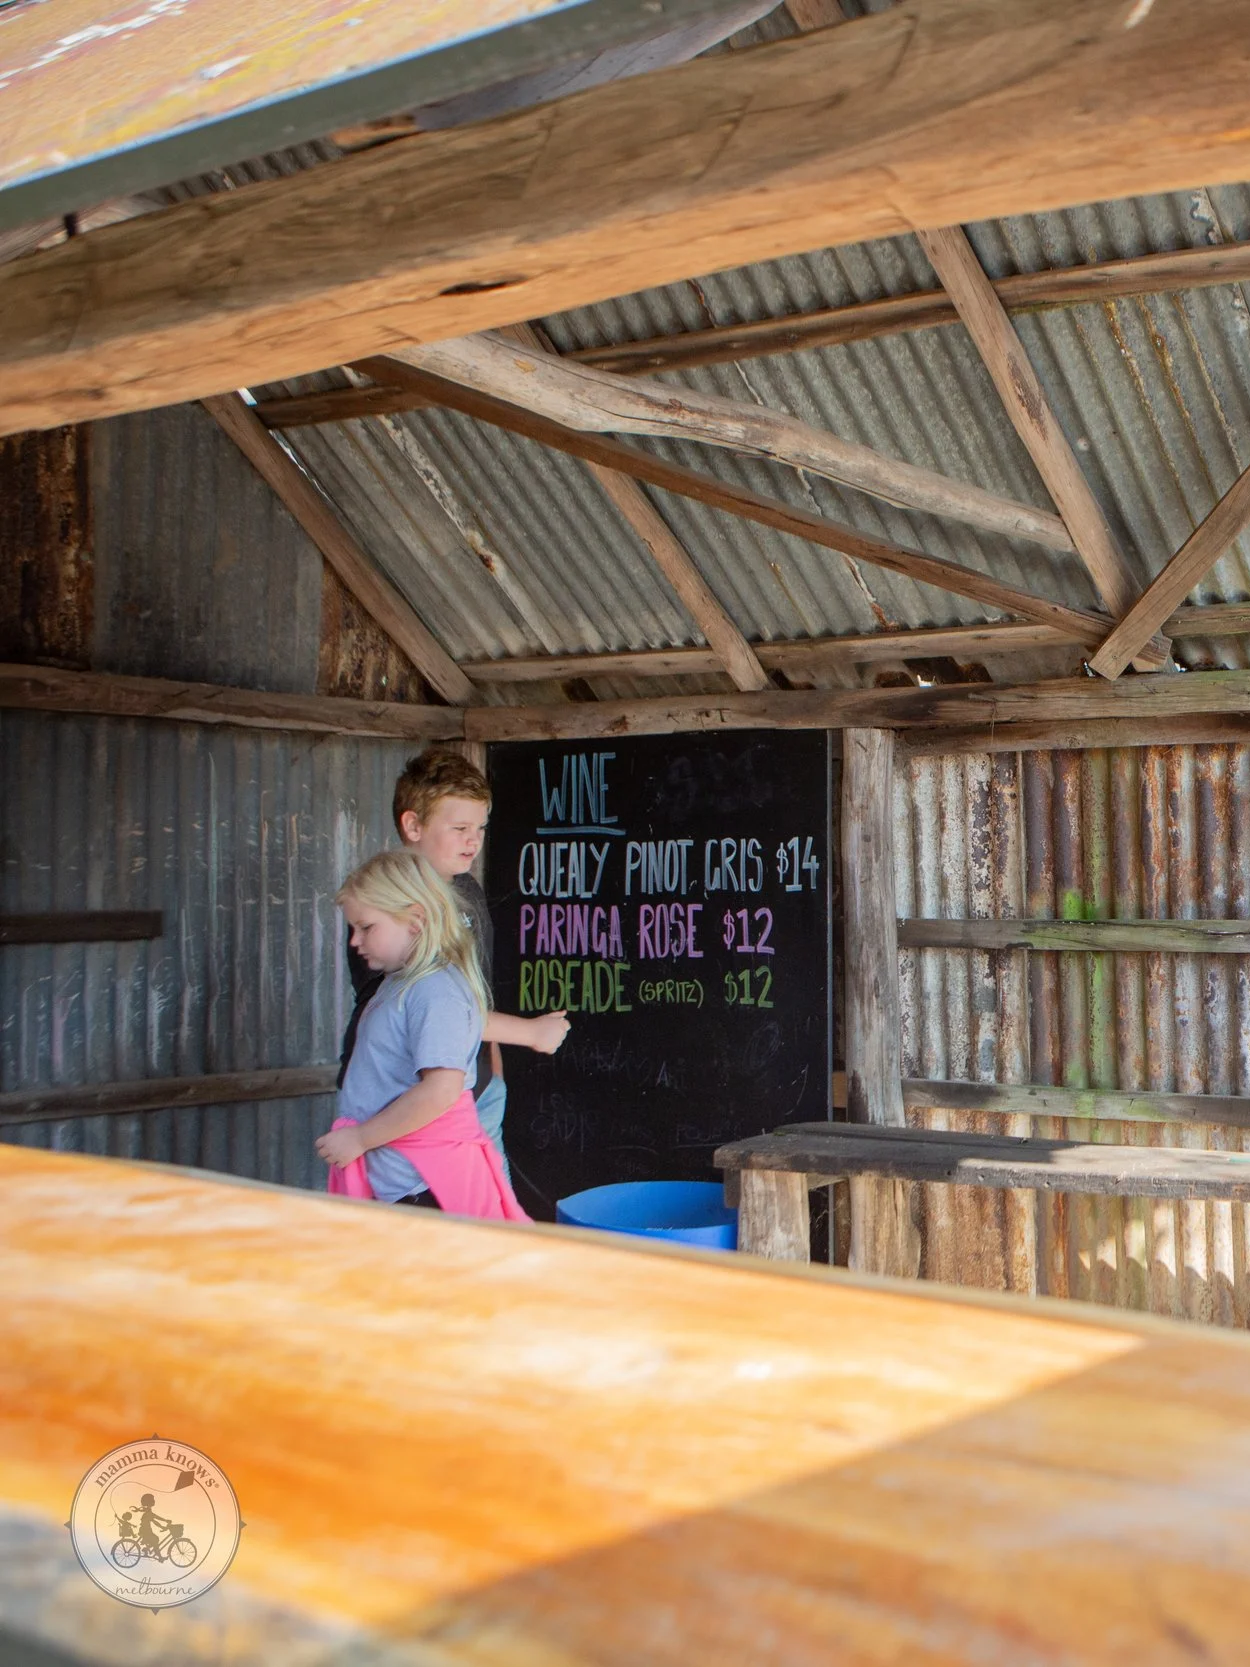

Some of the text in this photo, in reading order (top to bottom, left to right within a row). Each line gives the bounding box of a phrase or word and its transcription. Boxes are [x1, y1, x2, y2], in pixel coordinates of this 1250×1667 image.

[538, 752, 619, 824] WINE
[518, 836, 820, 898] QUEALY PINOT GRIS $14
[519, 903, 776, 959] PARINGA ROSE $12
[519, 960, 774, 1014] ROSEADE (SPRITZ) $12
